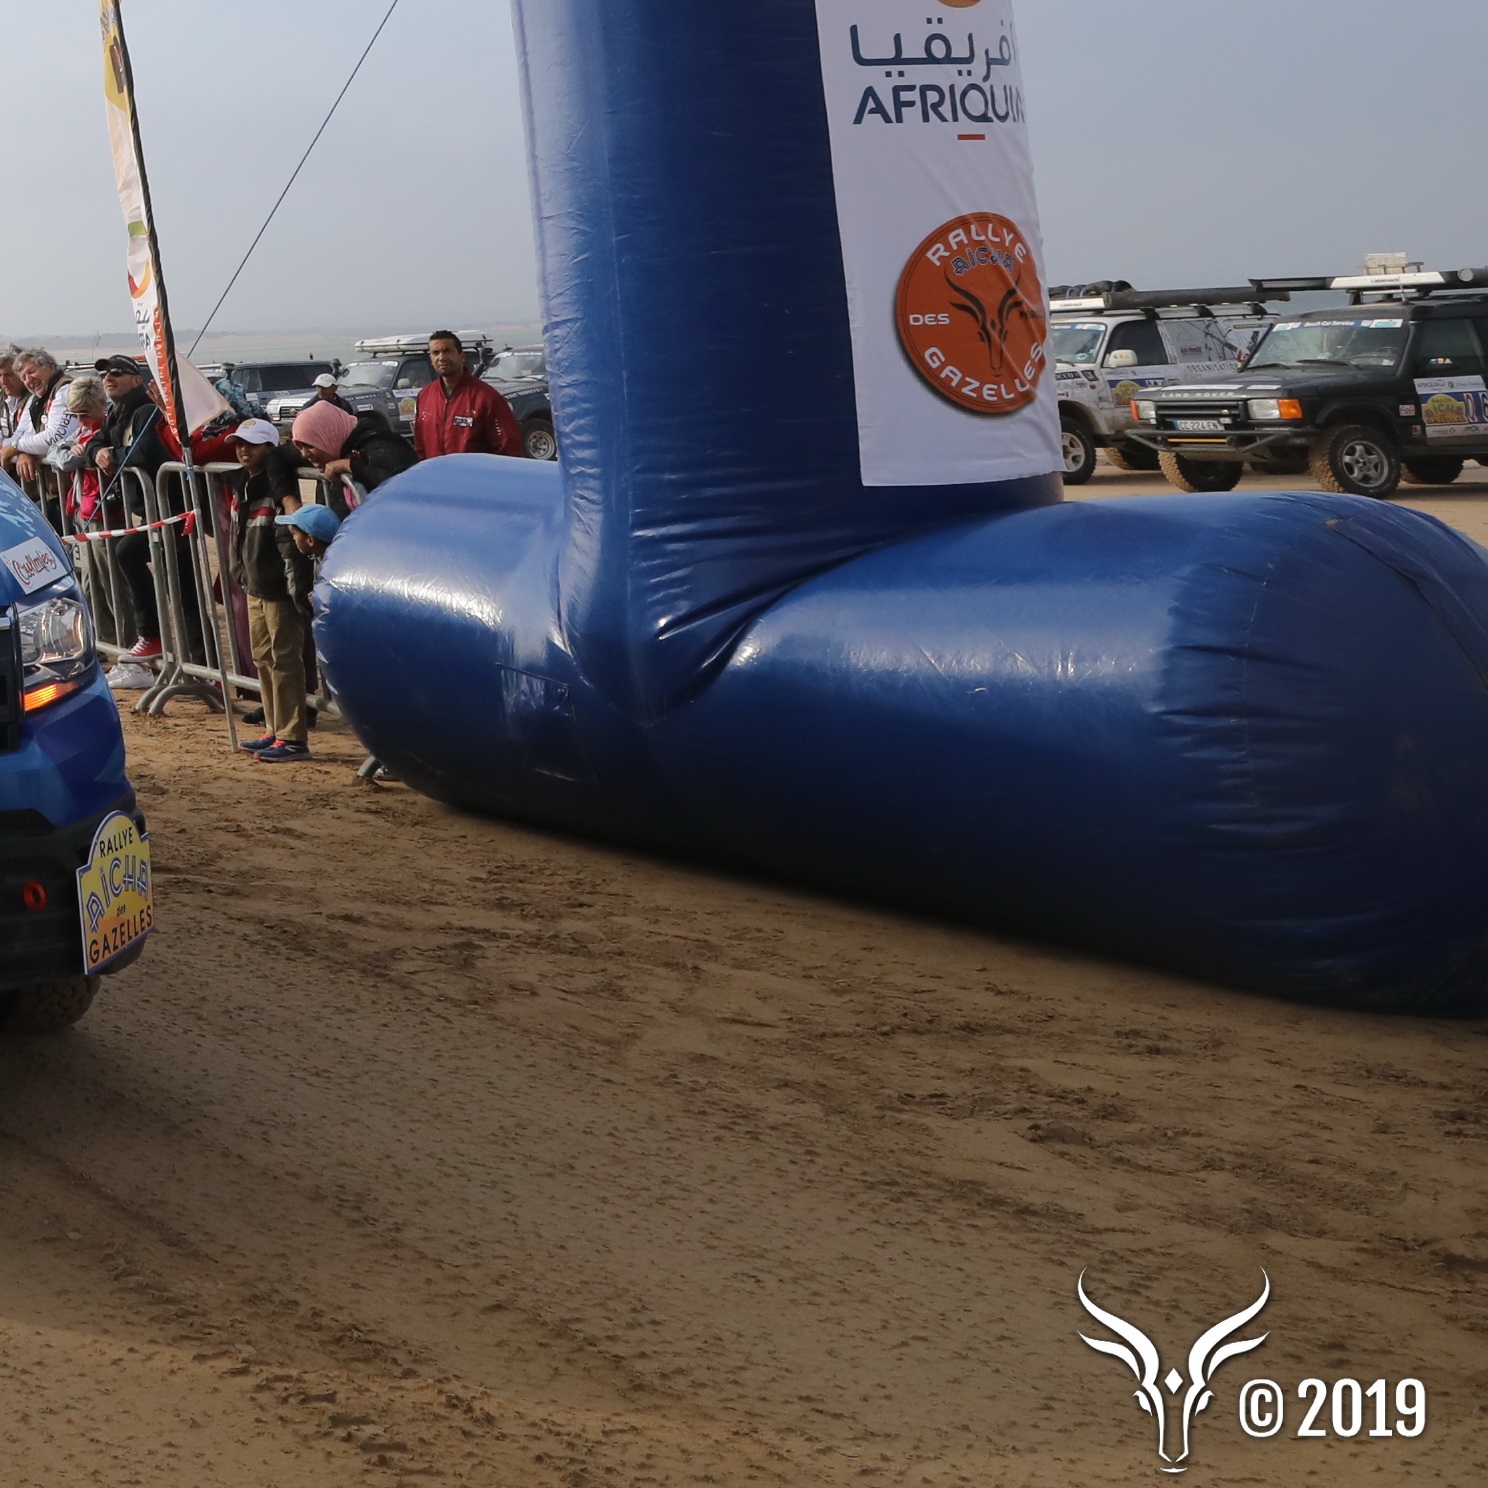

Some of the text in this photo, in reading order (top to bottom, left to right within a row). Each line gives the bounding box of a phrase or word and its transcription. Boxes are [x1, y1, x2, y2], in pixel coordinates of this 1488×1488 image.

[926, 223, 1027, 267] RALLYE
[909, 313, 950, 326] DES
[924, 341, 1044, 401] GAZELLES
[100, 827, 133, 858] RALLYE
[89, 905, 152, 964] GAZELLES
